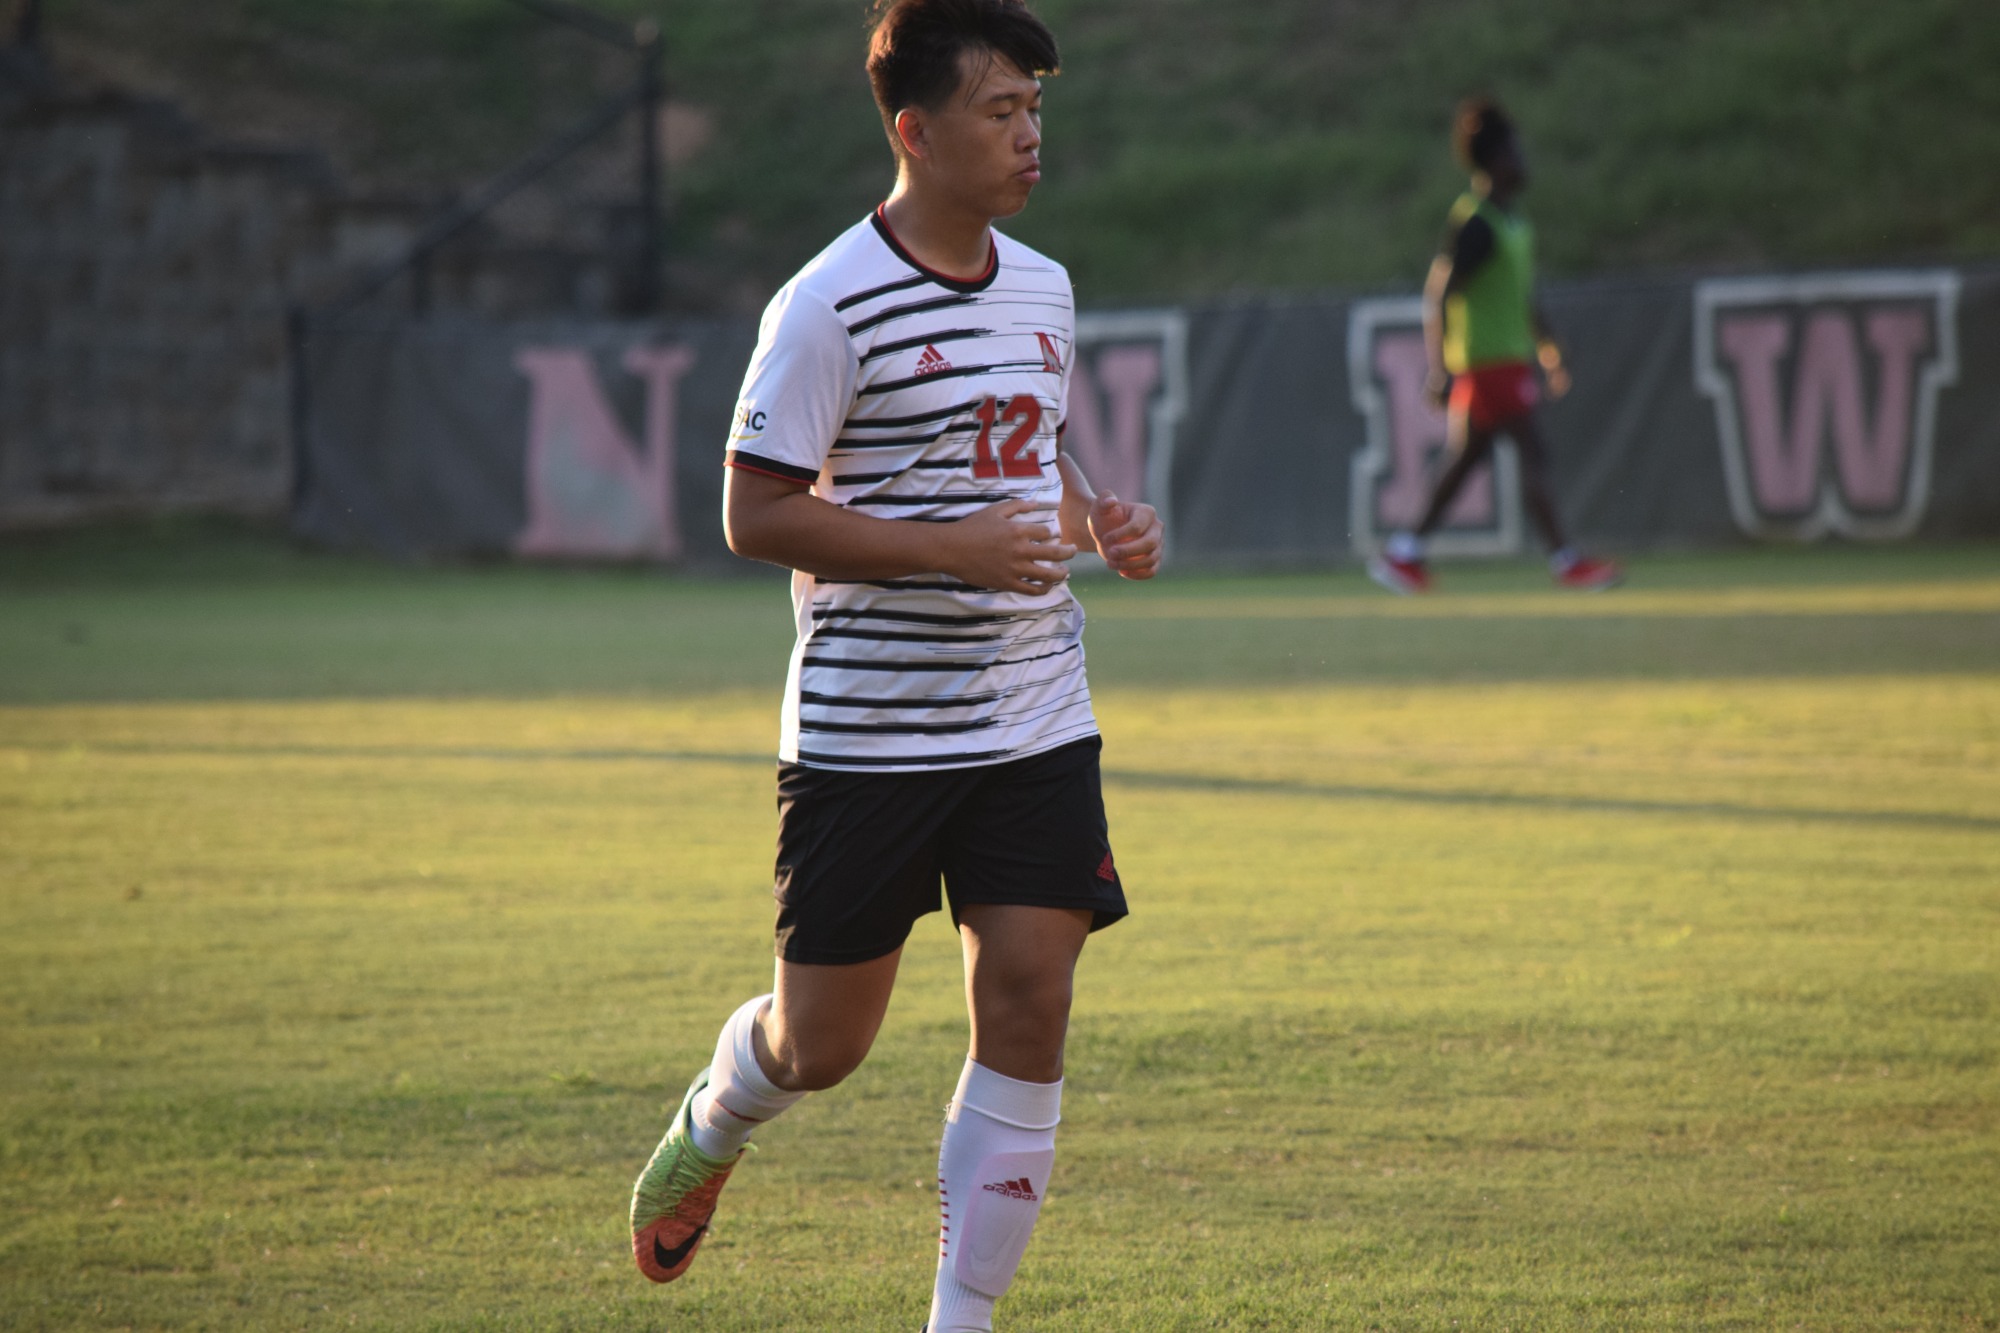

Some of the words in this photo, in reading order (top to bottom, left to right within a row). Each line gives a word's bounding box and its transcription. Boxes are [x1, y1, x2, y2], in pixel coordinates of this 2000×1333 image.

[914, 361, 952, 377] adidas
[516, 345, 694, 558] N
[970, 393, 1045, 480] 12
[983, 1184, 1038, 1201] adidas
